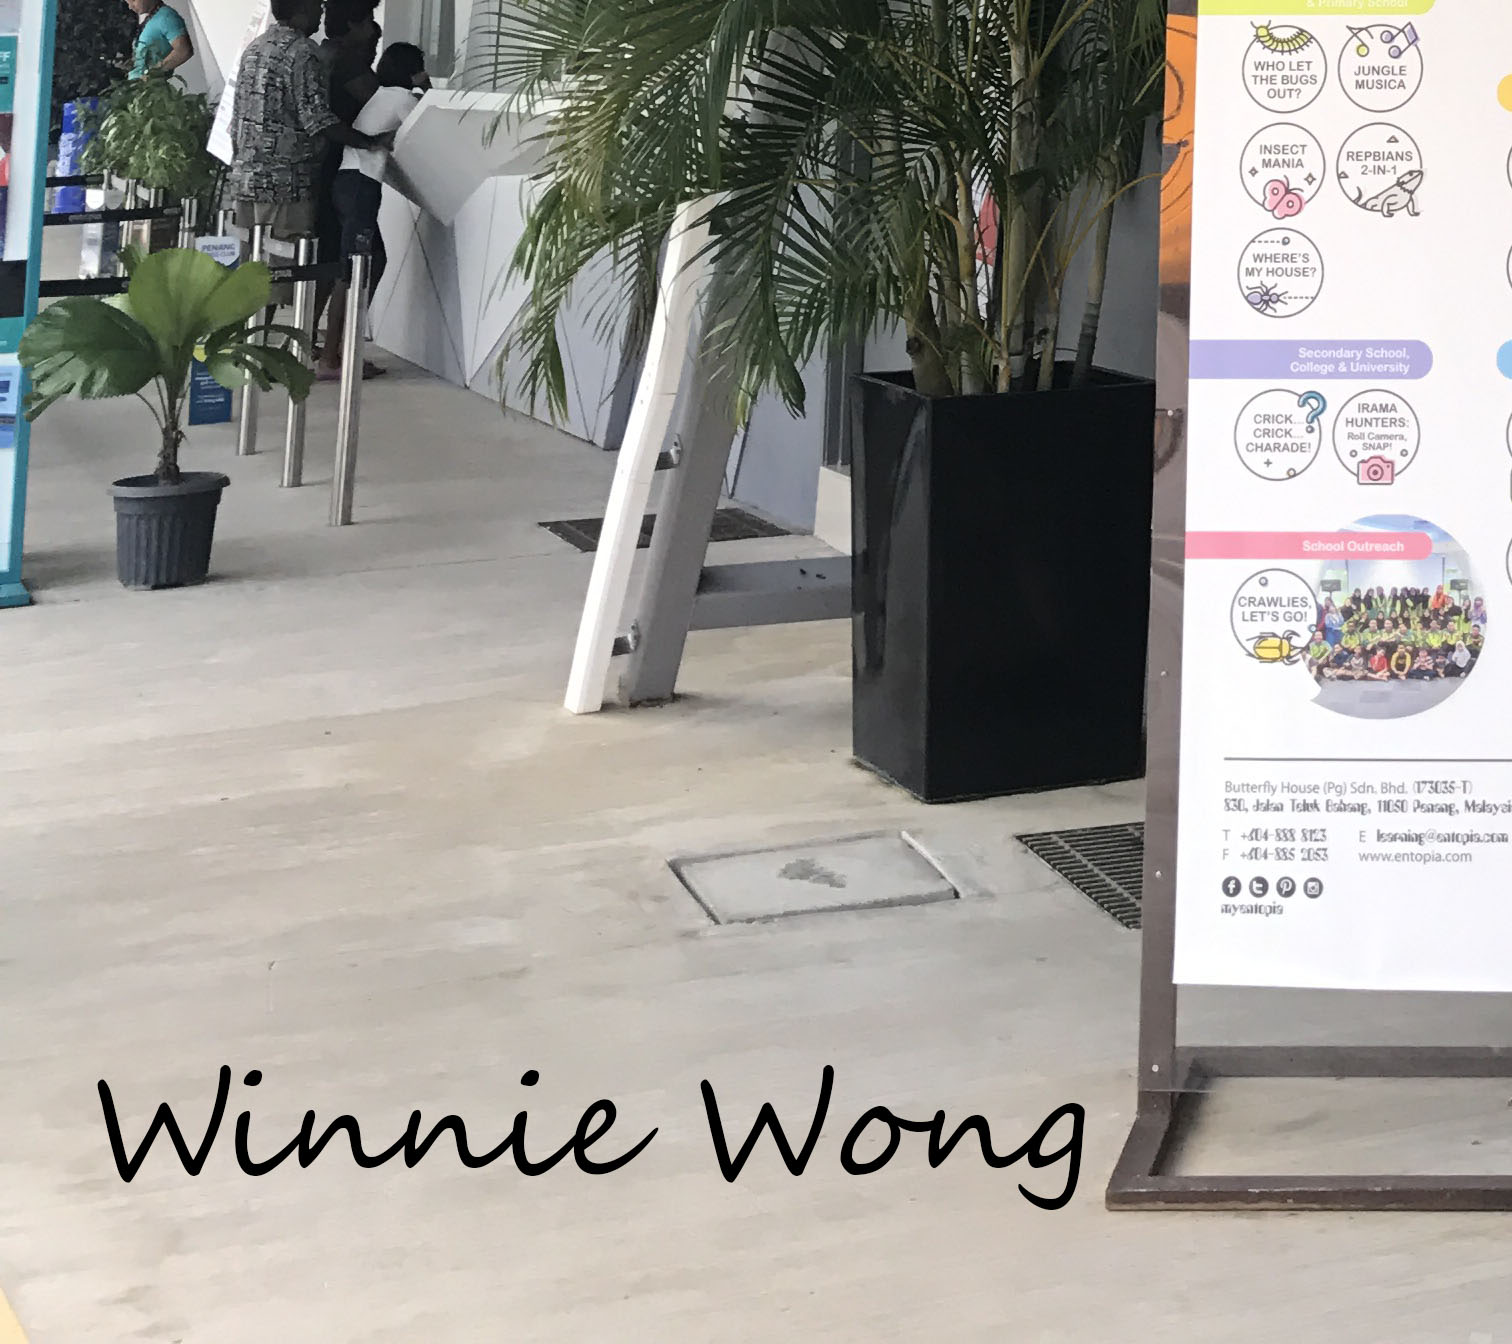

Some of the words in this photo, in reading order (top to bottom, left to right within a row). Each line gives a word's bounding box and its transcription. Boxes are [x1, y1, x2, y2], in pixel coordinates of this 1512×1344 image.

[1254, 61, 1285, 72] WHO
[1289, 61, 1312, 72] LET
[1354, 66, 1407, 76] JUNGLE
[1252, 75, 1277, 85] THE
[1281, 75, 1317, 85] BUGS
[1355, 79, 1406, 90] MUSICA
[1267, 88, 1302, 99] OUT?
[1260, 144, 1307, 155] INSECT
[1346, 151, 1413, 162] REPBIANS
[1262, 158, 1304, 168] MANIA
[1361, 165, 1397, 175] 2-IN-1
[1252, 253, 1309, 263] WHERE'S
[1245, 267, 1263, 277] MY
[1266, 266, 1317, 278] HOUSE?
[1298, 347, 1362, 360] Secondary
[1365, 347, 1410, 360] School,
[1290, 362, 1335, 374] College
[1338, 362, 1347, 372] &
[1351, 361, 1410, 375] University
[1358, 403, 1397, 413] IRAMA
[1345, 417, 1410, 428] HUNTERS:
[1347, 431, 1364, 441] Roll
[1367, 431, 1407, 442] Camera,
[1246, 442, 1311, 453] CHARADE!
[1362, 442, 1393, 451] SNAP!
[1302, 540, 1344, 552] School
[1347, 540, 1405, 552] Outreach
[1241, 611, 1280, 622] LET'S
[1283, 611, 1307, 622] GO!
[1225, 781, 1277, 796] Butterfly
[1281, 781, 1320, 794] House
[1323, 781, 1347, 796] (Pg)
[1350, 781, 1377, 794] Sdn.
[1380, 781, 1408, 794] Bhd.
[1252, 798, 1284, 813] Jalan
[1222, 829, 1231, 841] T
[1359, 830, 1367, 842] E
[1222, 848, 1229, 861] F
[1358, 849, 1473, 865] www.entopia.com
